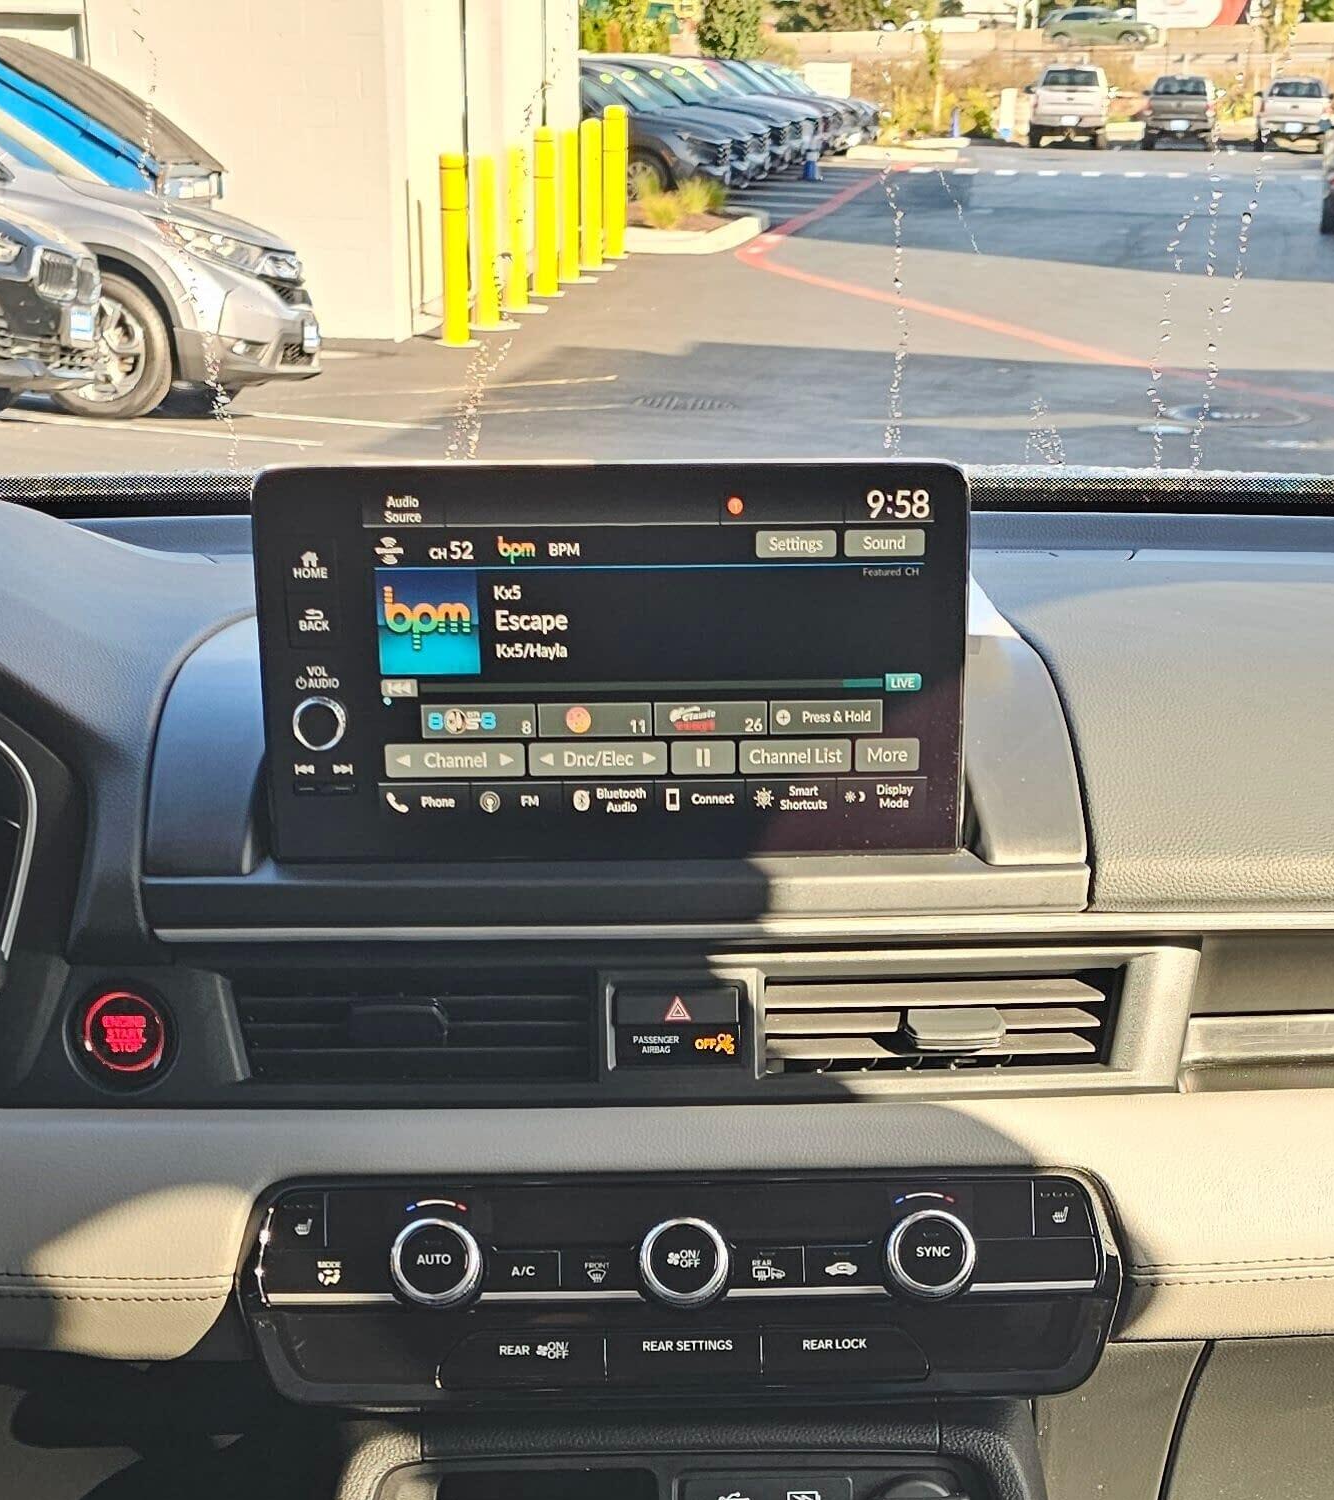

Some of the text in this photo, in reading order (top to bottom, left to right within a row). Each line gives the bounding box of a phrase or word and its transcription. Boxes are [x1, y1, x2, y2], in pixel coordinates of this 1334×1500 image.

[386, 495, 419, 508] Audio
[866, 489, 930, 518] 9:58
[384, 511, 422, 524] Source
[769, 537, 823, 553] Settings
[863, 535, 906, 550] Sound
[428, 541, 474, 560] CH 52
[497, 536, 580, 564] bpm BPM
[293, 567, 328, 579] HOME
[862, 567, 919, 577] Featured CH
[493, 585, 522, 600] Kx5
[299, 619, 330, 632] BACK
[494, 610, 569, 635] Escape
[495, 643, 569, 661] Kx5/Hayla
[306, 666, 328, 678] VOL
[308, 677, 340, 690] AUDIO
[890, 677, 915, 689] LIVE
[802, 710, 871, 724] Press & Hold
[521, 721, 532, 735] 8
[630, 720, 646, 734] 11
[744, 718, 763, 733] 26
[423, 751, 488, 770] Channel
[563, 750, 634, 771] Dnc/Elec
[749, 747, 843, 766] Channel List
[867, 746, 908, 763] More
[596, 786, 646, 800] Bluetooth
[691, 791, 735, 805] Connect
[789, 785, 819, 798] Smart
[876, 784, 914, 800] Display
[421, 795, 455, 809] Phone
[520, 795, 540, 808] FM
[606, 801, 637, 814] Audio
[779, 798, 828, 812] Shortcuts
[879, 798, 909, 810] Mode
[632, 1035, 679, 1044] PASSENGER
[694, 1038, 716, 1050] OFF
[641, 1045, 671, 1054] AIRBAG
[680, 1250, 701, 1260] ON/
[915, 1246, 951, 1259] SYNC
[416, 1253, 452, 1266] AUTO
[679, 1259, 701, 1269] OFF
[751, 1259, 772, 1268] REAR
[511, 1265, 536, 1277] A/C
[584, 1262, 610, 1271] FRONT
[499, 1344, 530, 1357] REAR
[548, 1342, 569, 1352] ON/
[642, 1339, 734, 1352] REAR SETTINGS
[802, 1337, 868, 1351] REAR LOCK
[547, 1351, 569, 1360] OFF
